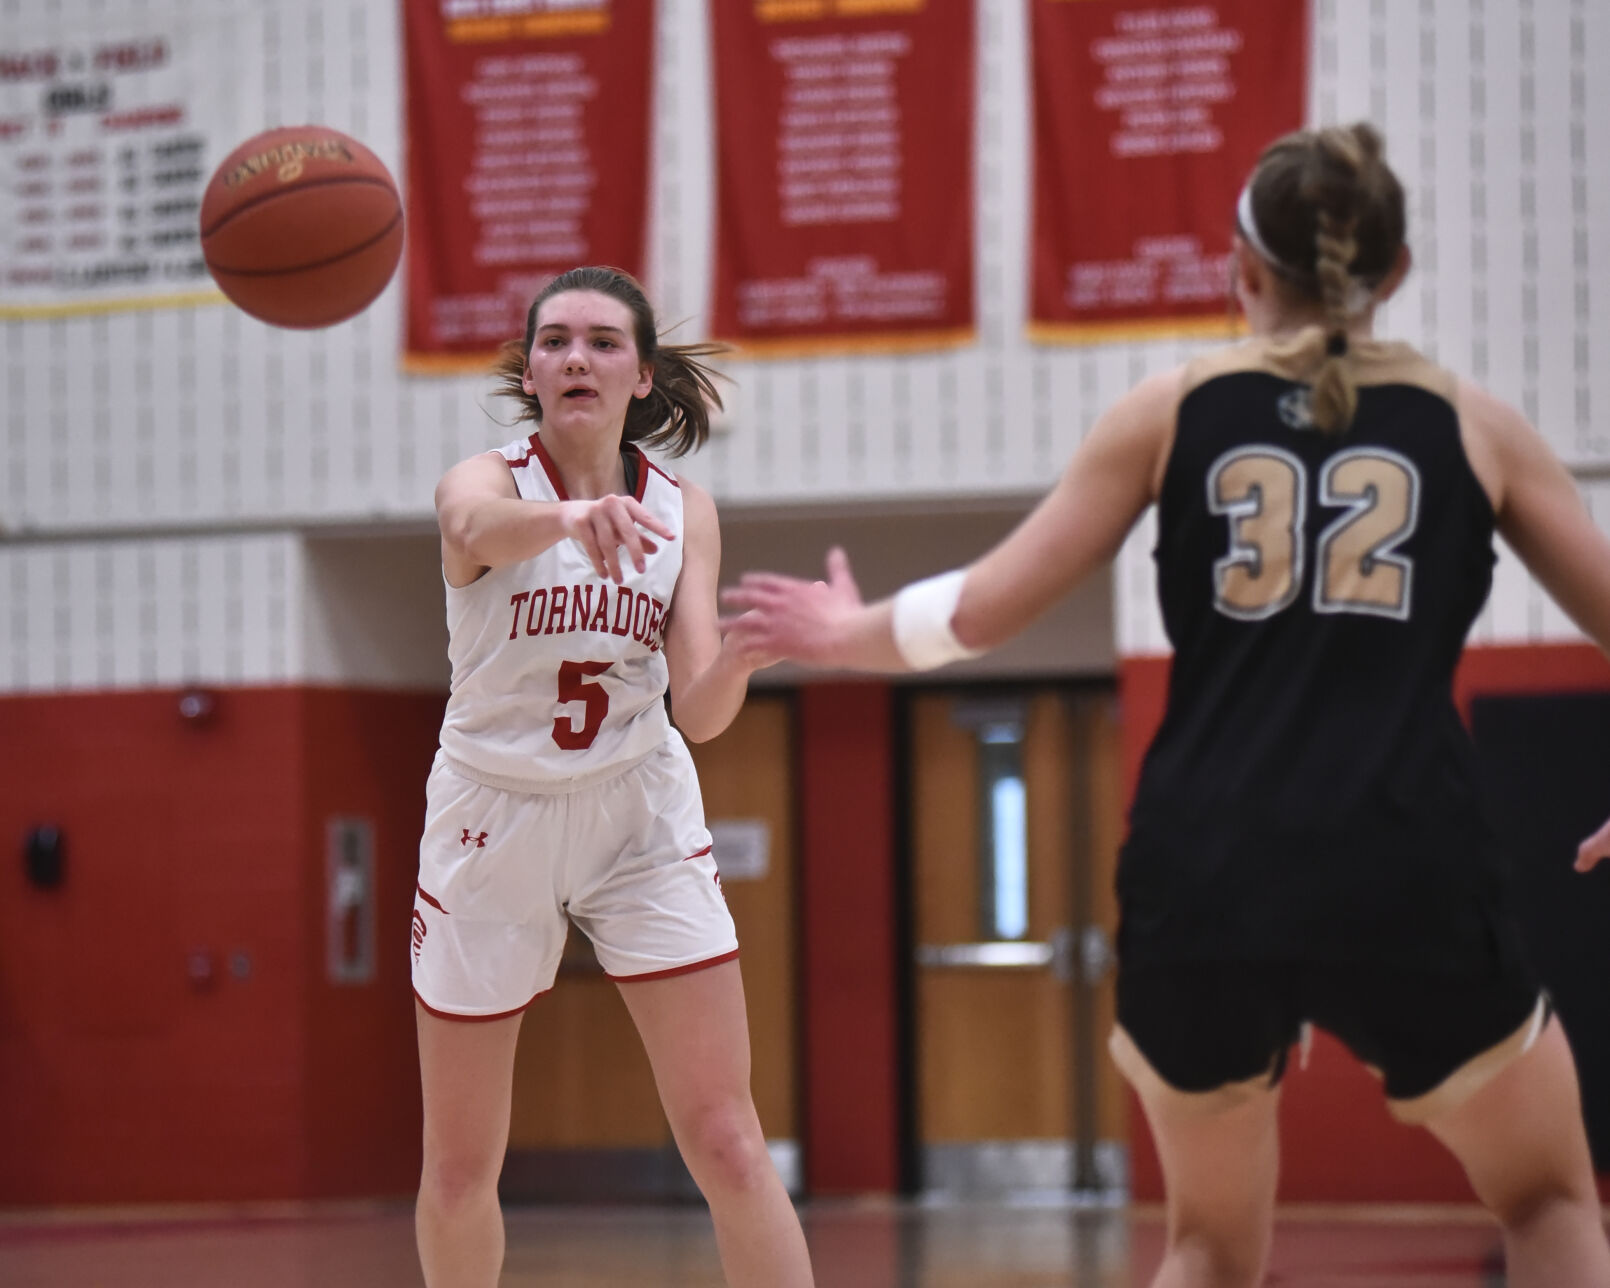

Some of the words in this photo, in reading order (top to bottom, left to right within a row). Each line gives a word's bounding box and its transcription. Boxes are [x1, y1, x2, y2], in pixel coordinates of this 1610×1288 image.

[1206, 443, 1421, 621] 32
[509, 584, 670, 653] TORNADOES
[551, 660, 615, 751] 5
